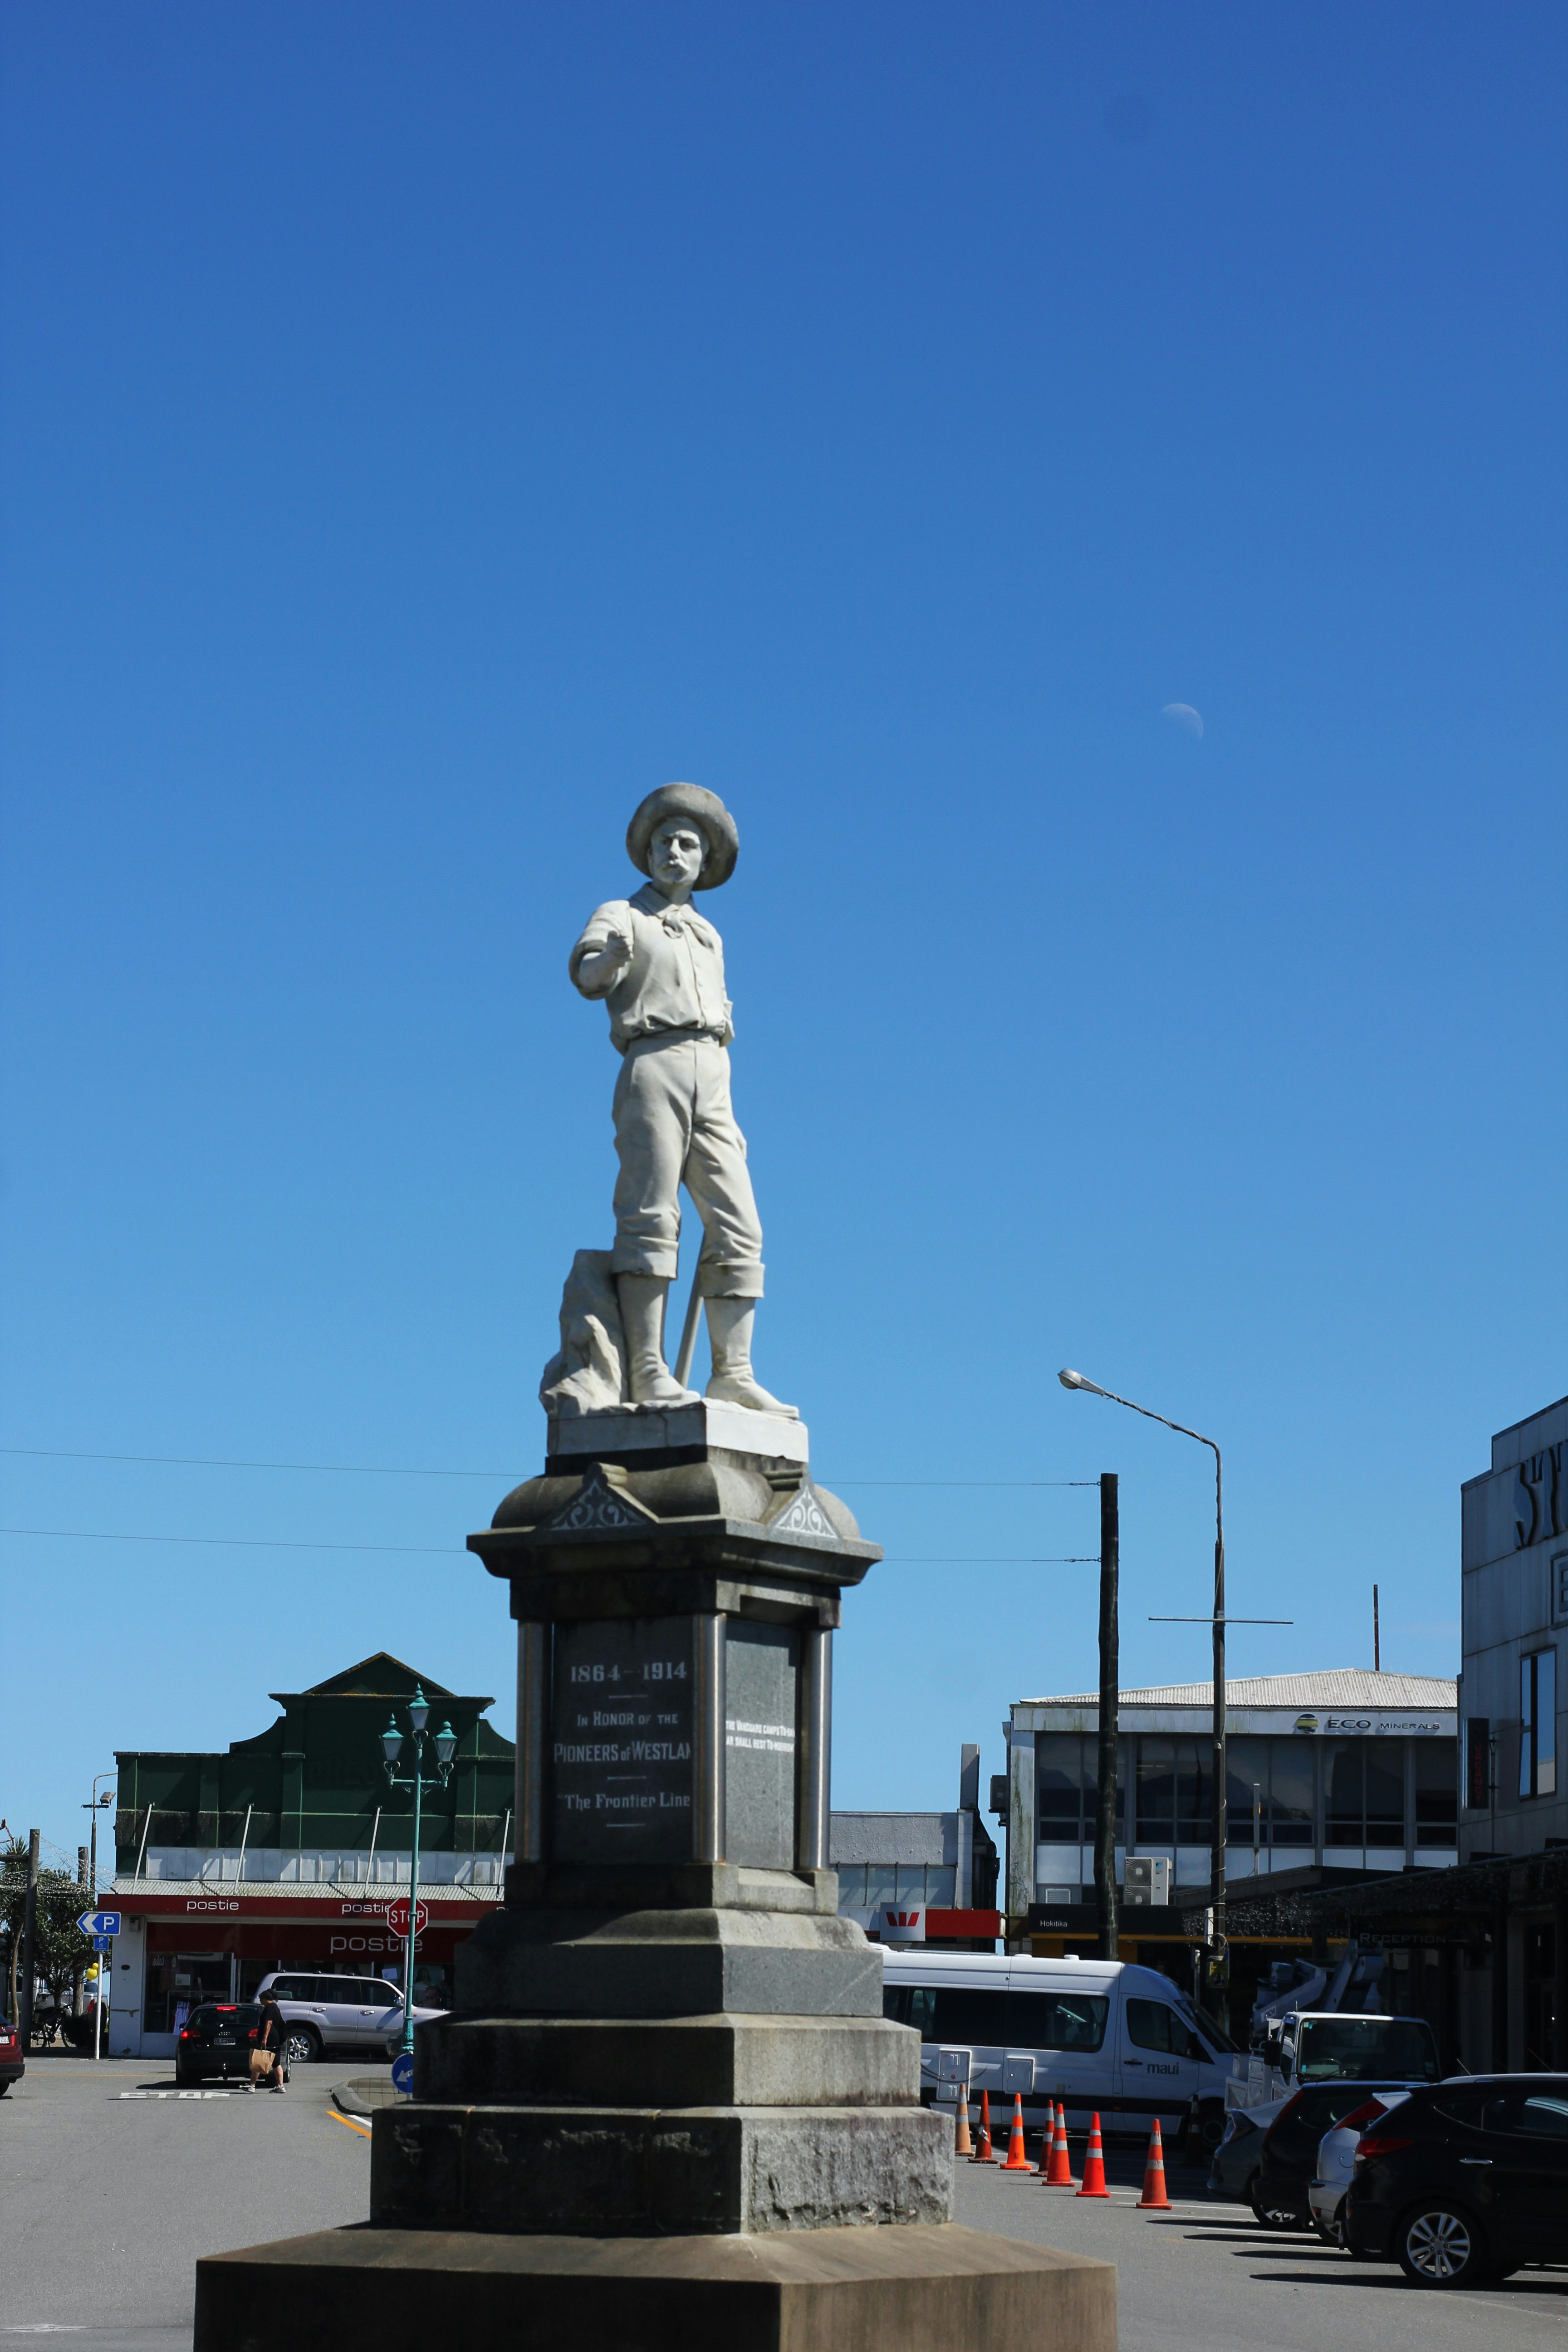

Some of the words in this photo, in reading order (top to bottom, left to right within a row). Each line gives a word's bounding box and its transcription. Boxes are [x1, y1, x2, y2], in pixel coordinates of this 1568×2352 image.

[1514, 1439, 1568, 1550] ST
[593, 1711, 635, 1726] HONOR
[657, 1713, 679, 1725] THE
[1328, 1719, 1372, 1730] ECO
[554, 1743, 618, 1764] PIONEERS
[595, 1793, 656, 1809] Frontier
[659, 1792, 691, 1808] Line
[187, 1900, 239, 1911] postie
[103, 1916, 115, 1930] P
[391, 1910, 424, 1923] STP
[1360, 1932, 1446, 1943] RECEPTION
[1147, 2062, 1180, 2075] maui
